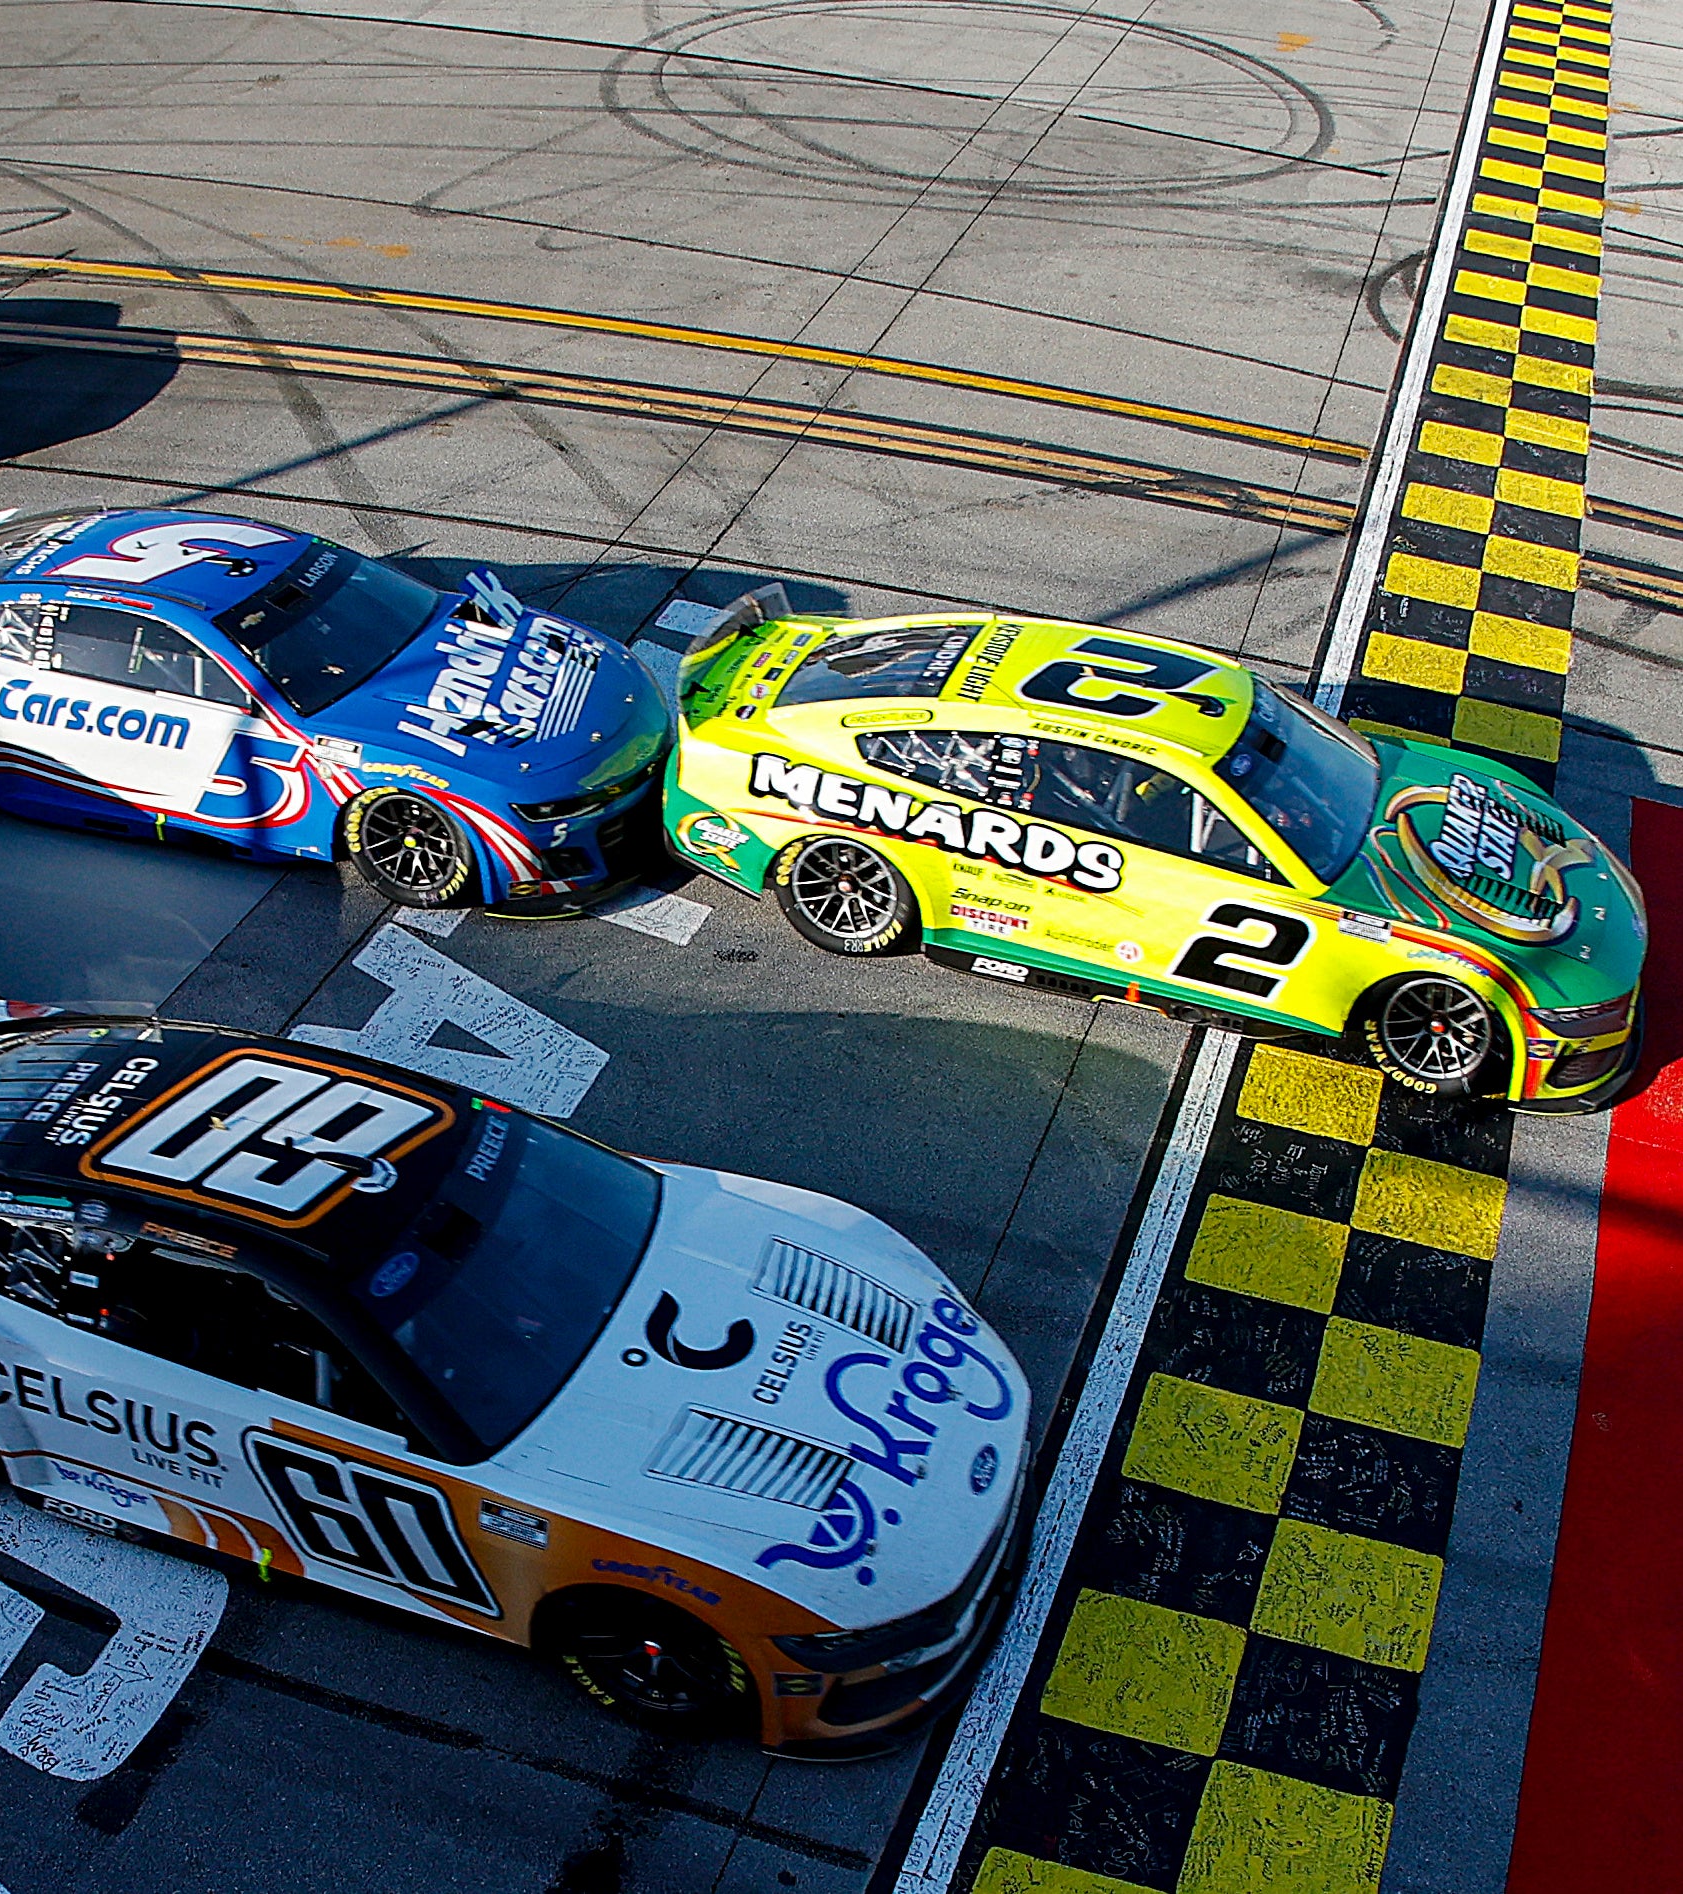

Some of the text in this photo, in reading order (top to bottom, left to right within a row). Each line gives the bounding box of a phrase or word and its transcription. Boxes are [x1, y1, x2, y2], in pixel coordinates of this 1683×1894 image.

[43, 521, 295, 584] 5
[297, 550, 340, 588] LARSON
[956, 623, 1025, 702] KEYSTONE LIGHT
[1019, 637, 1222, 718] 2
[1031, 721, 1158, 756] AUSTIN CINDRIC
[192, 730, 304, 825] 5
[550, 822, 569, 848] 5
[749, 752, 1125, 892] MENARDS
[1429, 773, 1489, 879] QUAKER
[1476, 801, 1519, 882] STATE
[949, 904, 1029, 931] DISCOUNT
[971, 920, 1007, 935] TIRE
[1171, 902, 1311, 999] 2
[971, 956, 1030, 980] FORD
[23, 1061, 103, 1124] PREECE
[58, 1057, 160, 1146] CELSIUS
[100, 1058, 435, 1213] 60
[752, 1320, 814, 1405] CELSIUS
[131, 1447, 223, 1489] LIVE FIT
[43, 1498, 118, 1531] FORD
[244, 1427, 502, 1620] 60
[591, 1558, 721, 1606] GOODYEAR
